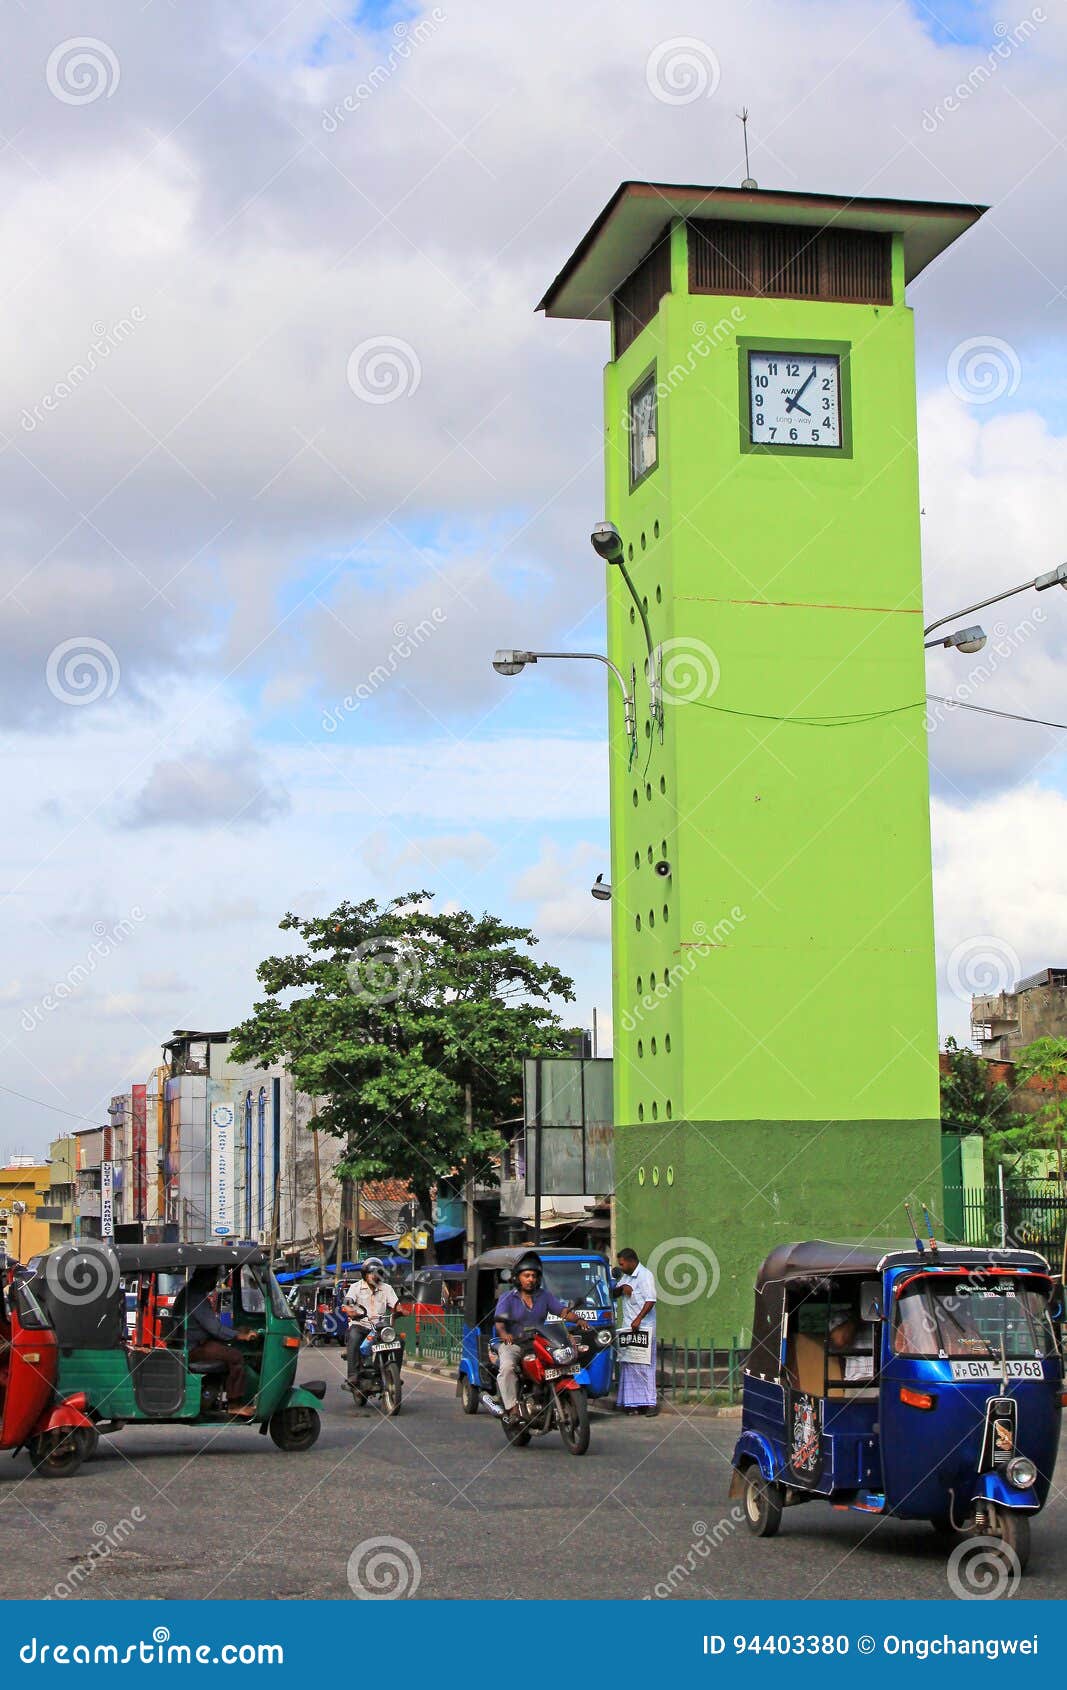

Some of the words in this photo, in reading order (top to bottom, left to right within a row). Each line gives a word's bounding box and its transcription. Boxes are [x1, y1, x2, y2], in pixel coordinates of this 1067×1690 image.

[767, 363, 778, 376] 11
[786, 364, 800, 377] 12
[754, 375, 769, 388] 10
[822, 378, 831, 391] 2
[754, 394, 764, 407] 9
[822, 397, 830, 410] 3
[755, 413, 765, 426] 8
[822, 416, 831, 429] 4
[768, 427, 777, 440] 7
[789, 427, 798, 441] 6
[811, 429, 820, 442] 5
[103, 1200, 111, 1235] PHARMACY
[968, 1362, 990, 1377] GM
[1005, 1361, 1042, 1377] 1968
